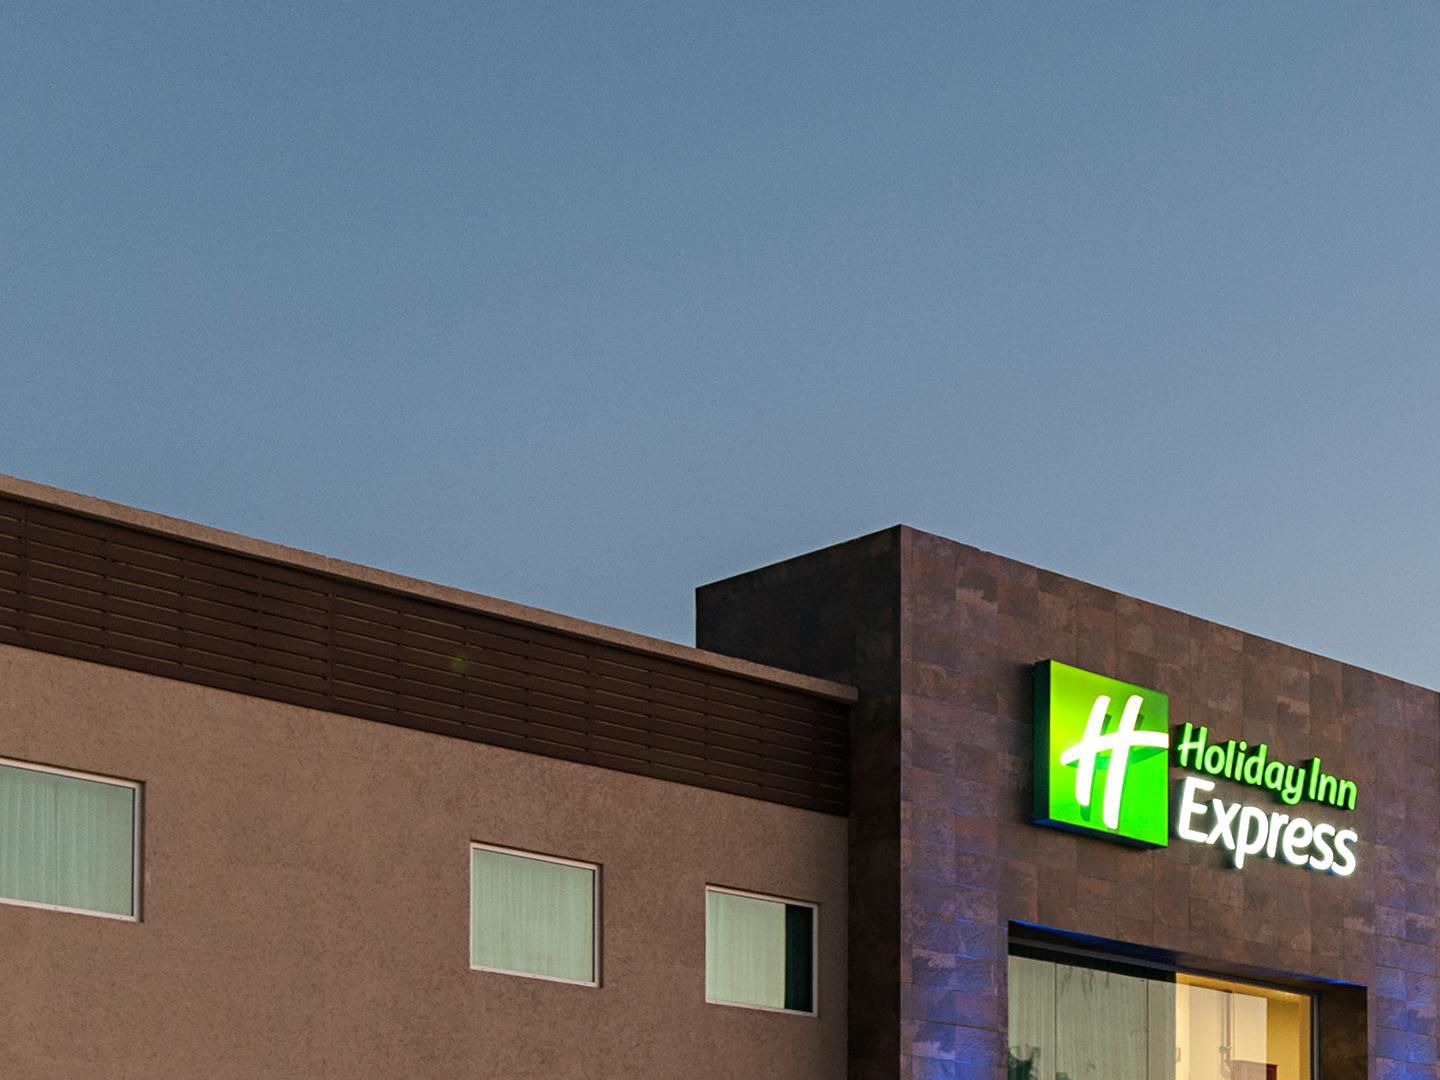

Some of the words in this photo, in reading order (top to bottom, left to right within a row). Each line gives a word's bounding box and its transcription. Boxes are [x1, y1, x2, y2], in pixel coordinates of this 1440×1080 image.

[1177, 721, 1306, 805] Holiday
[1308, 756, 1358, 811] Inn
[1178, 775, 1359, 877] Express
